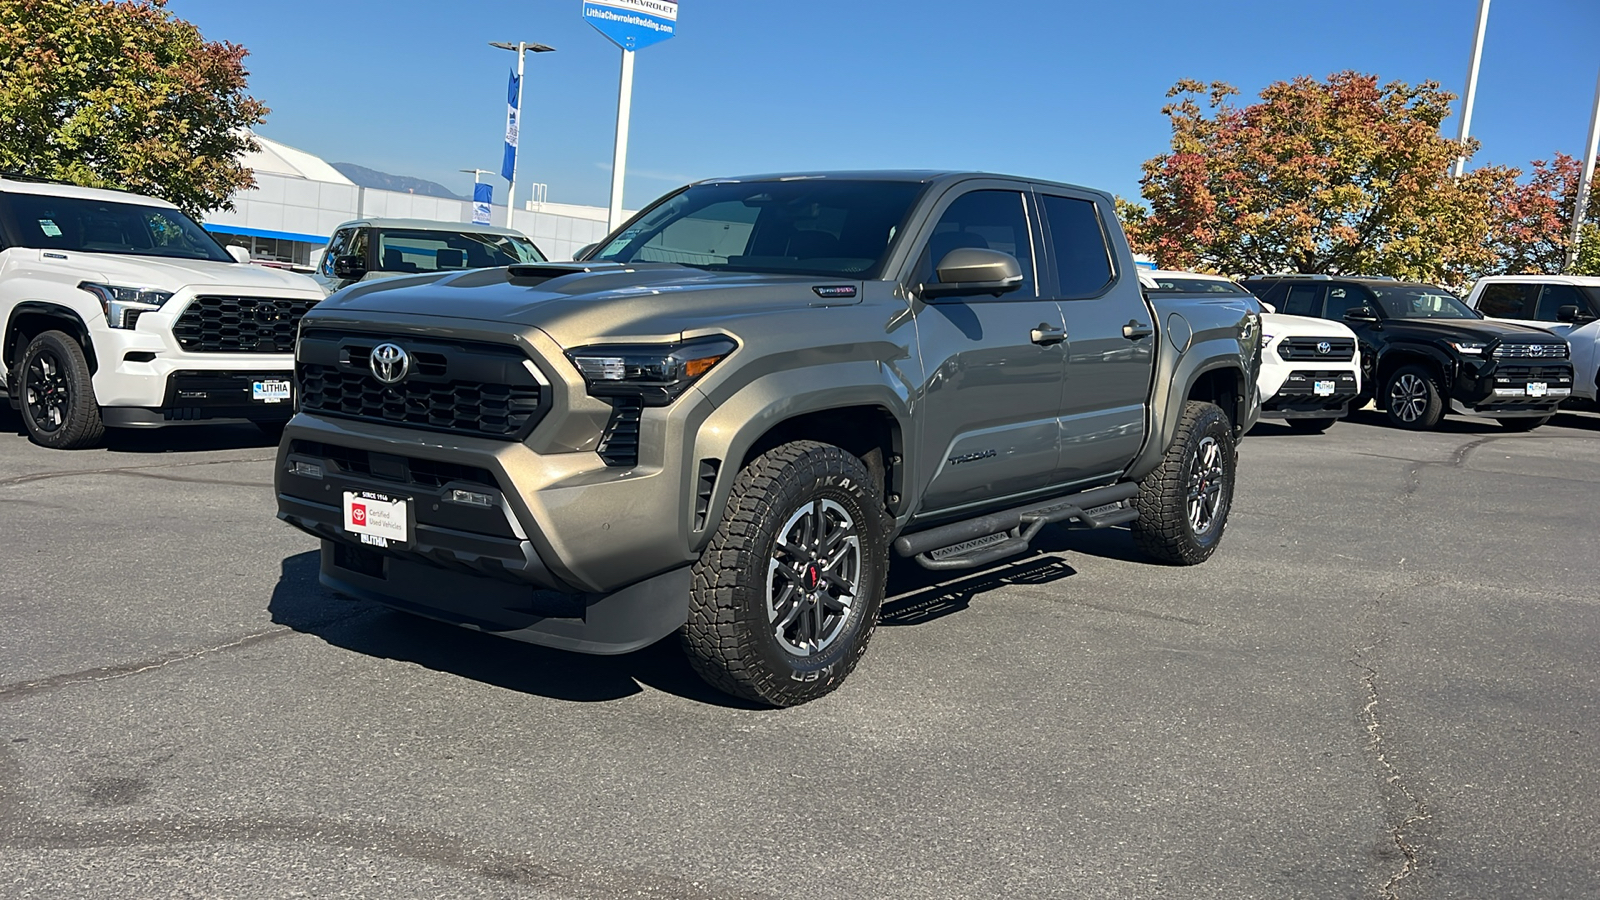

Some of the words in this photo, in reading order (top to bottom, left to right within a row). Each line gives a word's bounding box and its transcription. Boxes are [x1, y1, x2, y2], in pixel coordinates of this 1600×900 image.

[586, 8, 673, 33] LithiaChevroletRedding.com
[262, 384, 288, 392] LITHIA
[362, 491, 376, 500] SINCE
[369, 509, 390, 519] Certified
[369, 518, 382, 527] Used
[382, 520, 402, 531] Vehicles
